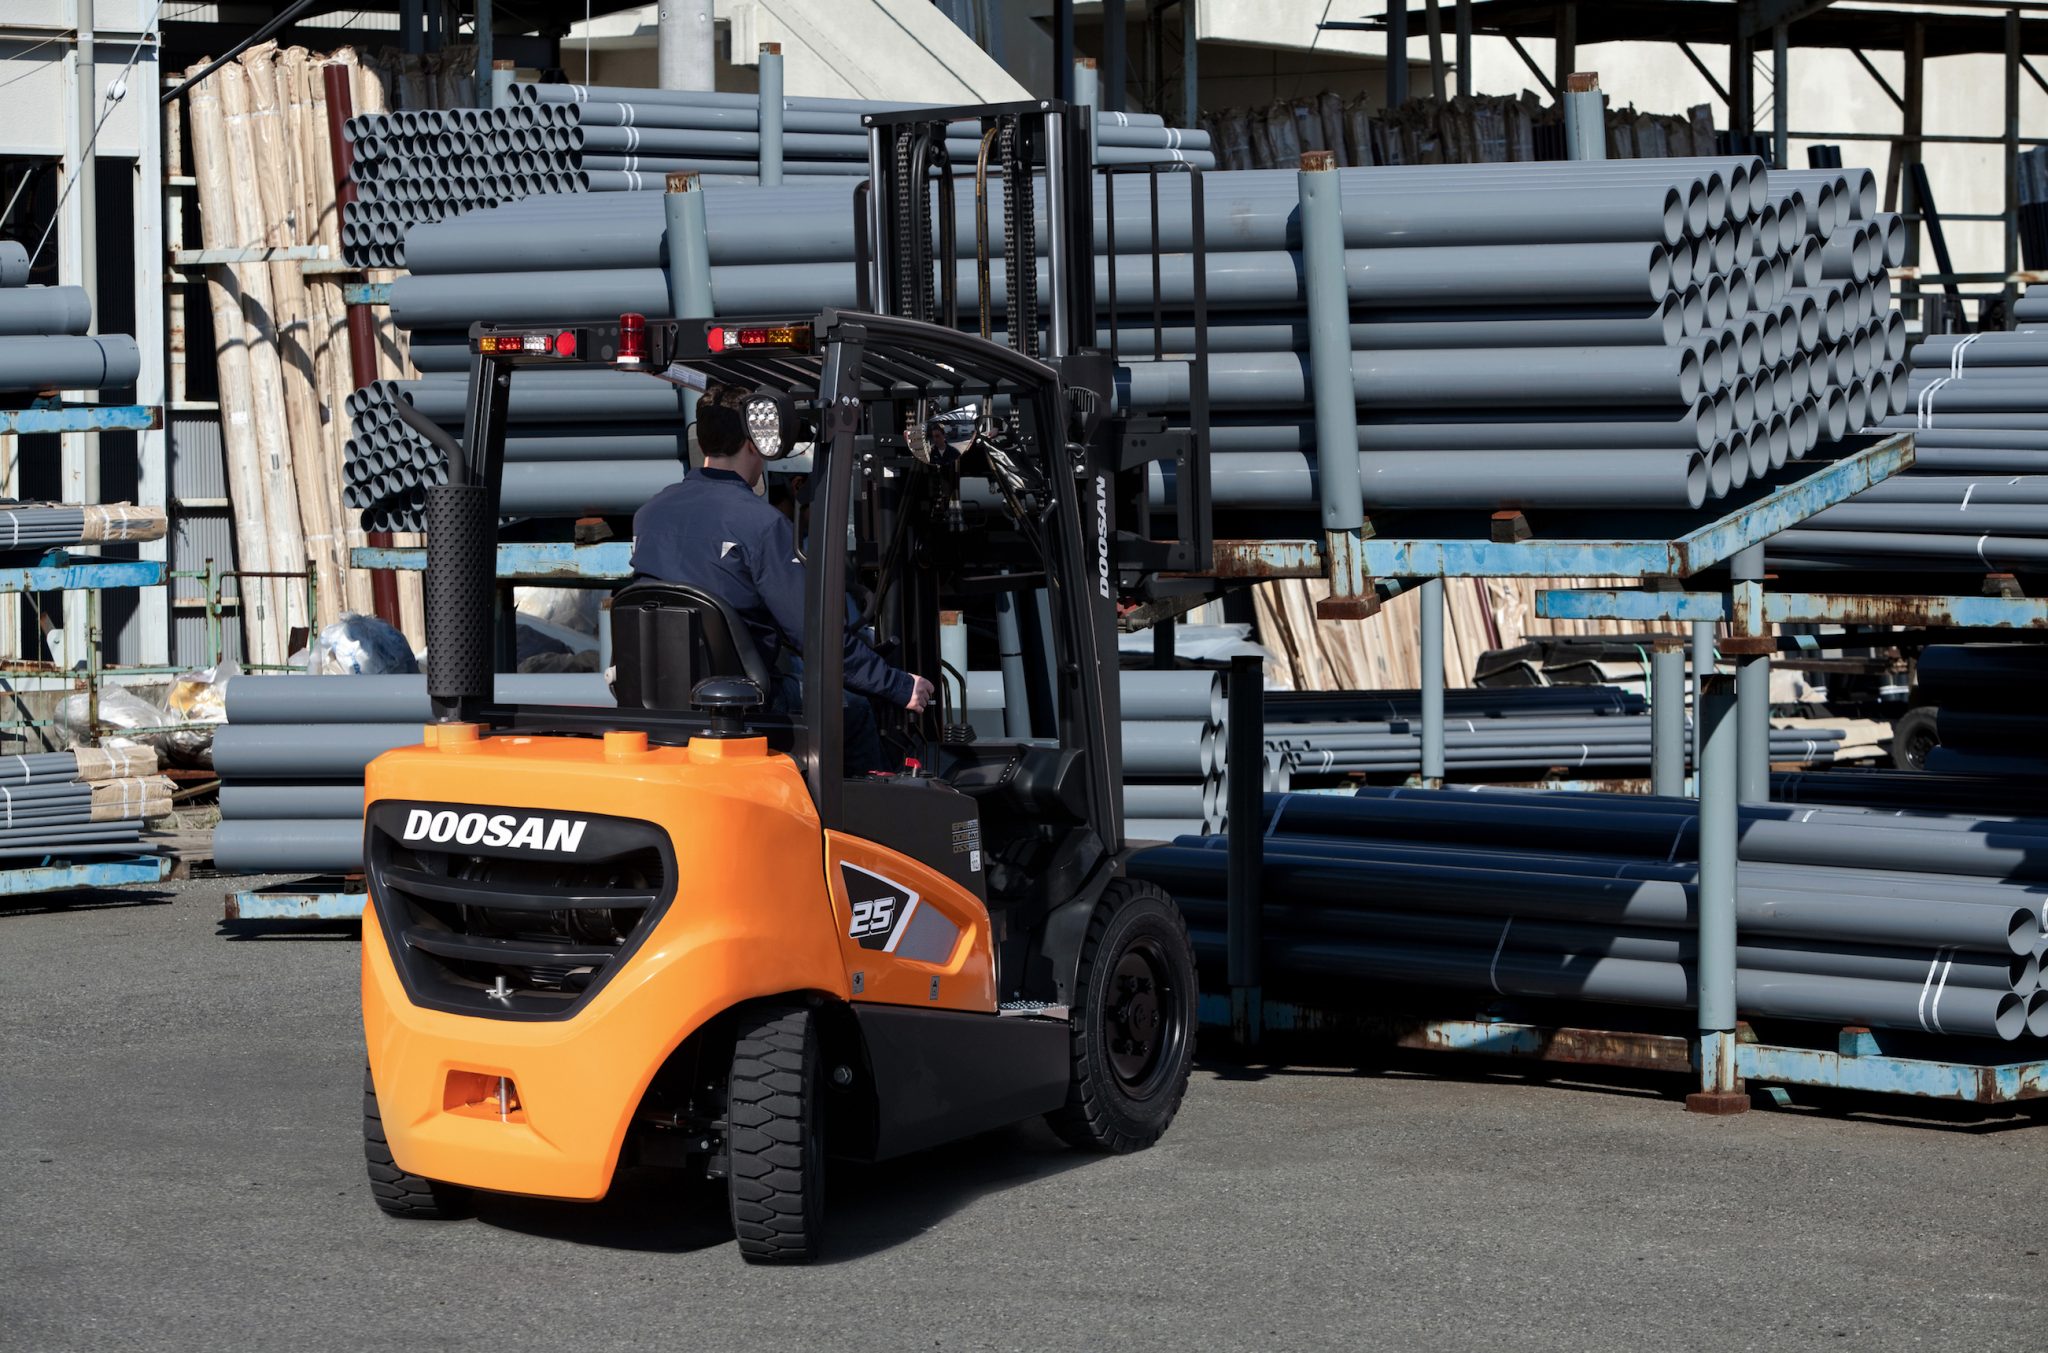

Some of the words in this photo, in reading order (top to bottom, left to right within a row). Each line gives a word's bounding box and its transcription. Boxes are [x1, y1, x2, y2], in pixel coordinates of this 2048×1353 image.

[1096, 475, 1110, 599] DOOSAN
[403, 809, 587, 853] DOOSAN
[849, 897, 896, 938] 25
